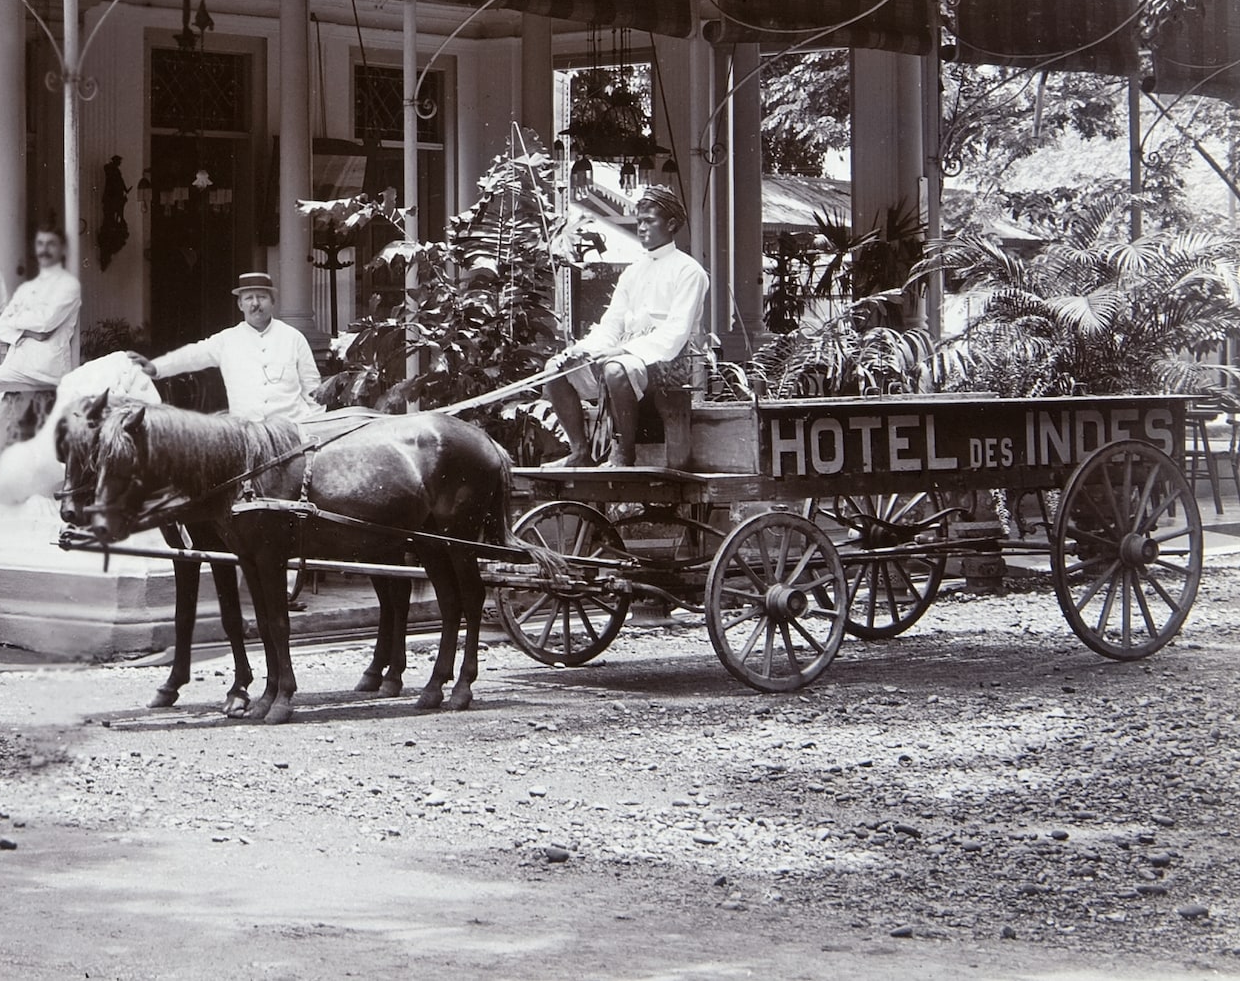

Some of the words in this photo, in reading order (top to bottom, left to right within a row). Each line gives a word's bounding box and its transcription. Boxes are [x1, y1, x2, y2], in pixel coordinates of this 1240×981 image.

[771, 414, 958, 477] HOTEL
[969, 437, 1013, 468] DES
[1025, 409, 1174, 465] INDES
